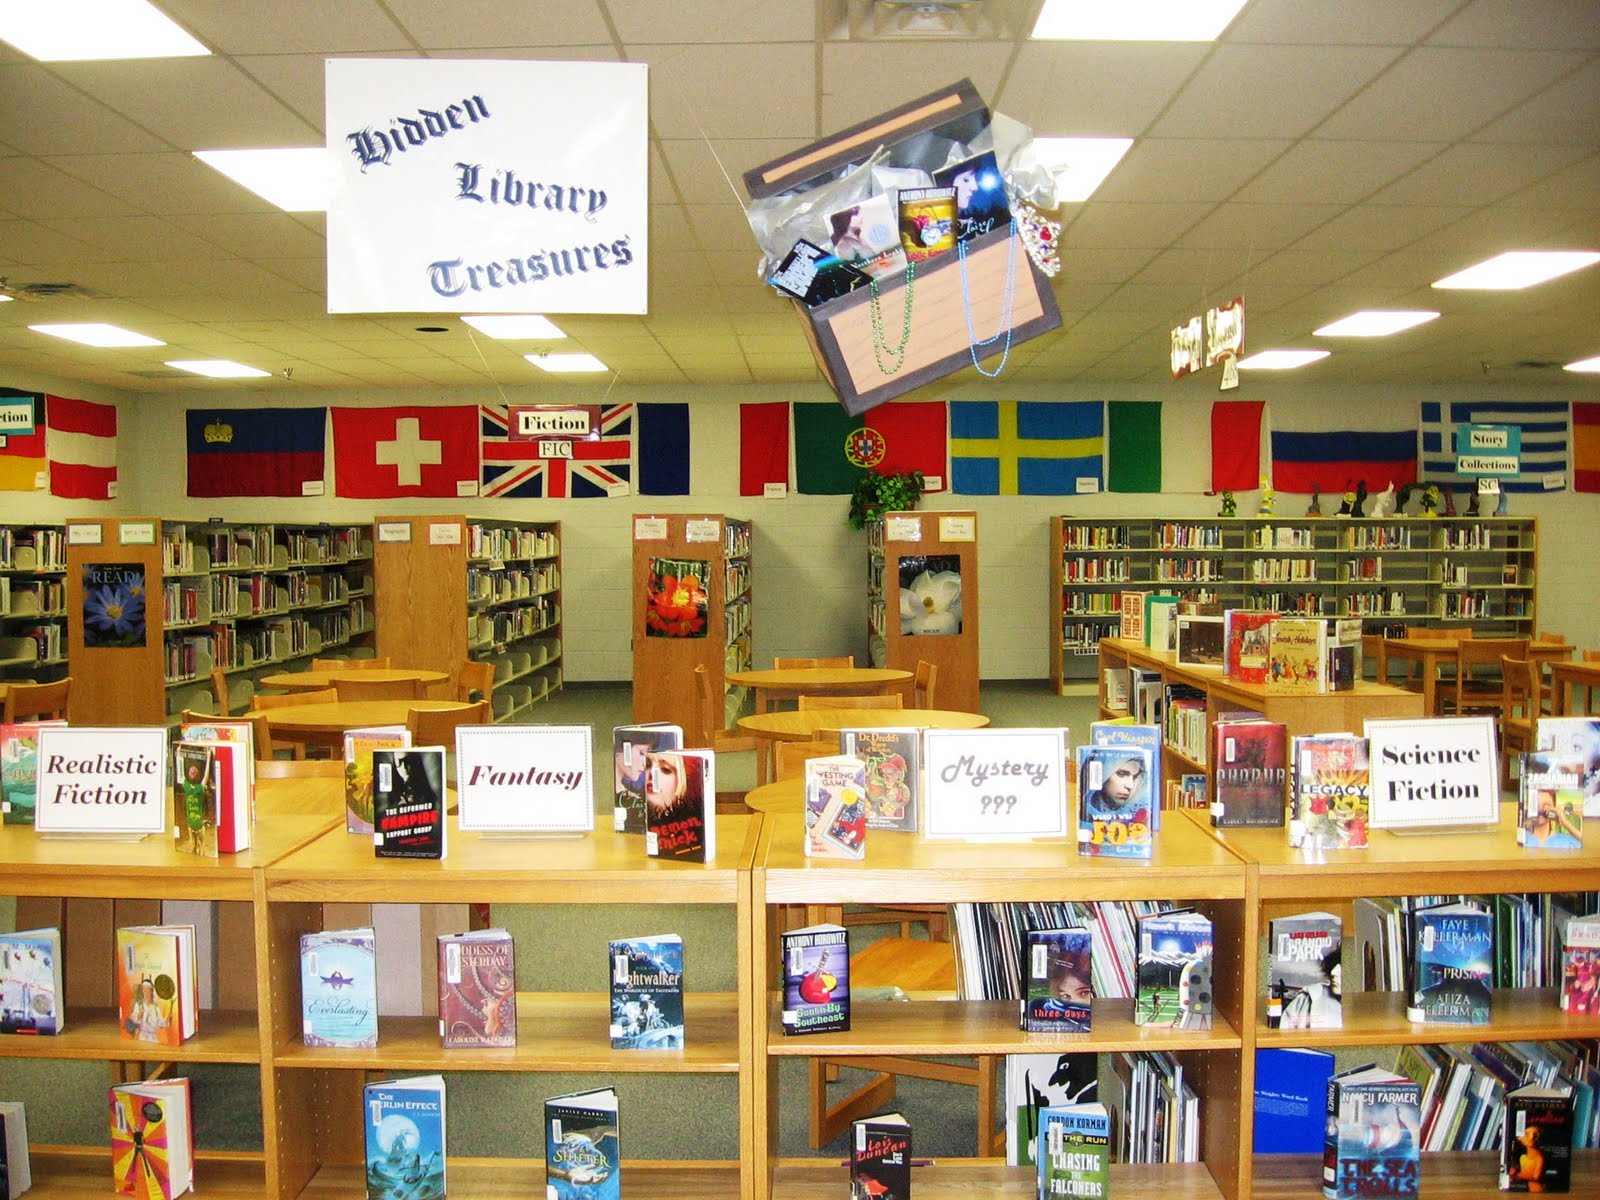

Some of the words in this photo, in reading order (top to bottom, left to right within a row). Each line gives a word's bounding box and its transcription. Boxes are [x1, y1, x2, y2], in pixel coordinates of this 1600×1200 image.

[346, 94, 491, 174] Hidden
[454, 161, 608, 223] Library
[426, 234, 633, 298] Treasures
[523, 415, 586, 432] Fiction
[1472, 433, 1504, 447] Story
[541, 442, 571, 457] FIC
[1459, 459, 1516, 470] Collections
[1479, 479, 1498, 491] SC
[92, 571, 136, 584] READ
[1381, 743, 1482, 767] Science
[46, 754, 157, 775] Realistic
[941, 754, 1050, 788] Mystery
[468, 765, 584, 791] Fantasy
[816, 771, 854, 780] WESTING
[821, 779, 847, 787] GAME
[53, 784, 149, 805] Fiction
[1300, 785, 1368, 797] LEGACY
[1388, 778, 1481, 802] Fiction
[385, 808, 398, 816] THE
[399, 802, 433, 814] REFORMED
[979, 794, 1018, 816] ???
[380, 809, 439, 831] VAMPIRE
[386, 829, 412, 838] SUPPORT
[413, 825, 433, 835] GROUP
[1442, 919, 1469, 930] FAYE
[786, 934, 814, 949] ANTHONY
[814, 932, 846, 946] HOROWITZ
[1418, 930, 1492, 942] KLLERMAN
[1436, 993, 1471, 1005] ALIZA
[308, 998, 369, 1026] Everlasting
[793, 1012, 845, 1028] Southeast
[1034, 1008, 1061, 1018] three
[1065, 1009, 1088, 1019] days
[1327, 1083, 1336, 1112] FARMER
[1378, 1092, 1418, 1106] FARMER
[405, 1101, 439, 1111] EFFECT
[1077, 1117, 1106, 1130] KORMAN
[868, 1135, 893, 1151] Lois
[1064, 1134, 1083, 1143] THE
[1086, 1136, 1107, 1144] RUN
[856, 1141, 907, 1161] Duncan
[1052, 1151, 1100, 1172] CHASING
[1050, 1178, 1102, 1197] FALCONERS
